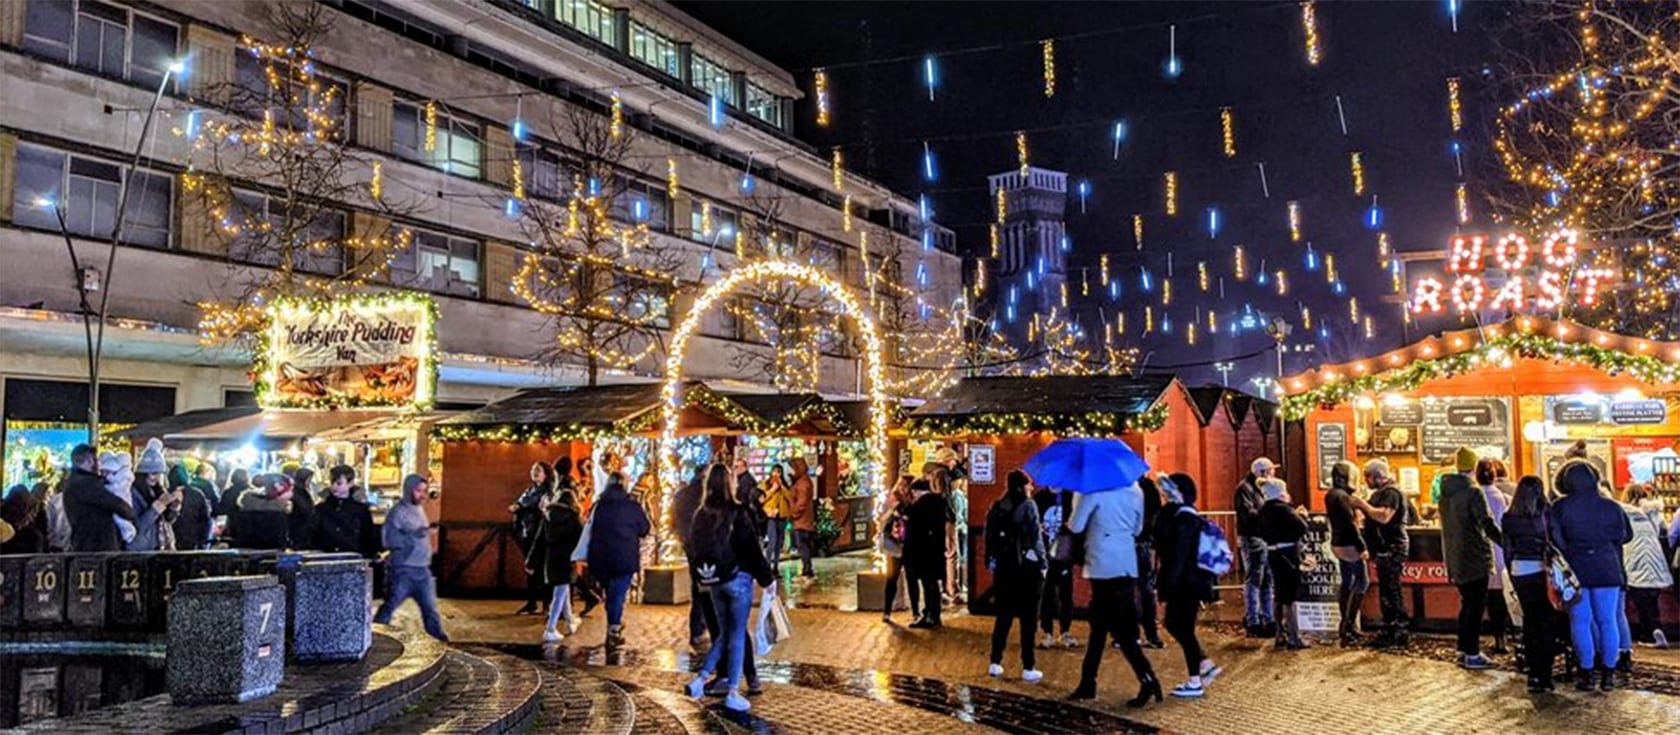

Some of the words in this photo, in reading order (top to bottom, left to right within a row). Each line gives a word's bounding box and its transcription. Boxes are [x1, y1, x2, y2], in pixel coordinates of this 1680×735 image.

[1445, 228, 1579, 272] HOG
[1411, 269, 1614, 313] ROAST
[338, 310, 356, 327] The
[285, 323, 349, 347] Yorkshire
[351, 319, 416, 344] Pudding
[336, 345, 357, 363] Van
[35, 571, 56, 590] 10
[78, 570, 96, 588] 11
[121, 570, 140, 589] 12
[1309, 585, 1335, 596] HERE
[259, 602, 273, 634] 7
